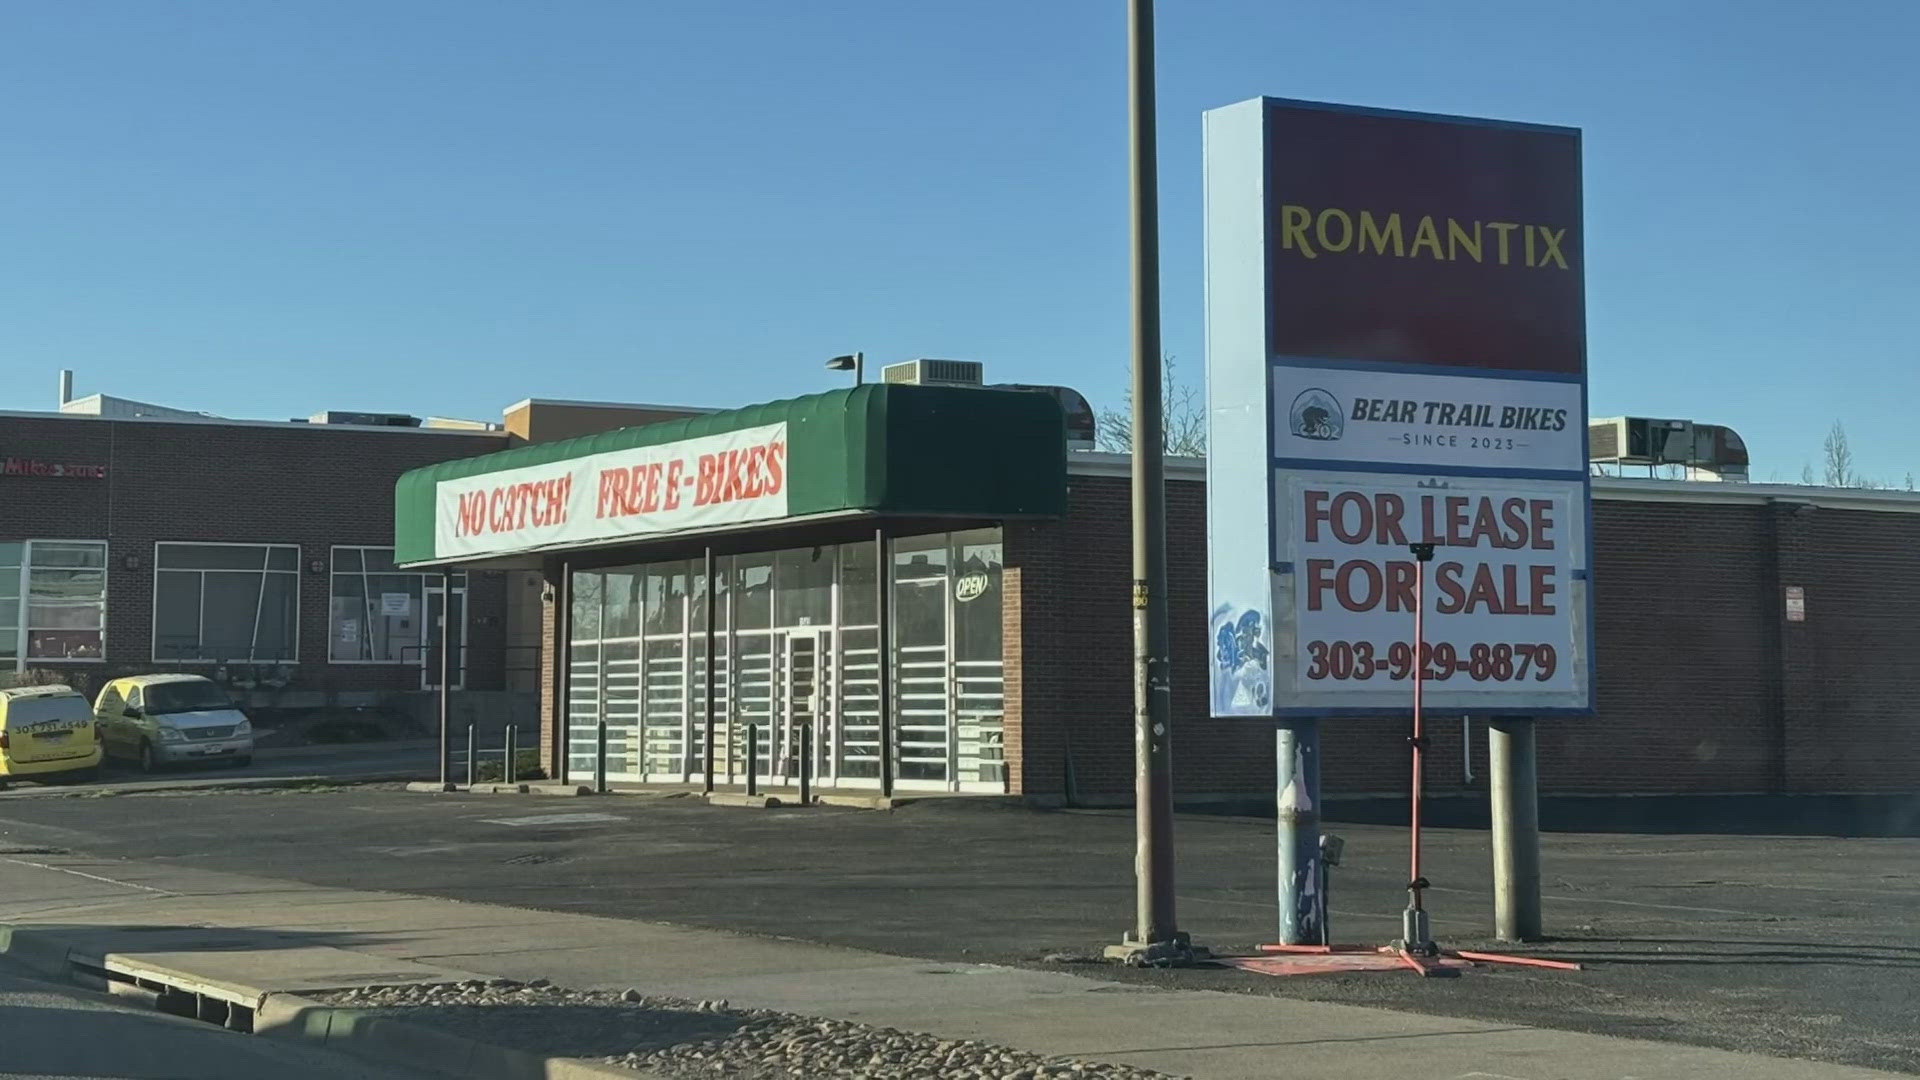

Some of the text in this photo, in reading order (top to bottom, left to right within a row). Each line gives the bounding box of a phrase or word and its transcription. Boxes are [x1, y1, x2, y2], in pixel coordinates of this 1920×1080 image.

[1281, 204, 1569, 270] ROMANTIX
[1351, 398, 1567, 431] BEAR TRAIL BIKES
[1403, 433, 1514, 450] SINCE 2023
[455, 490, 486, 538] NO
[489, 471, 572, 534] CATCH!
[596, 463, 663, 520] FREE
[1304, 491, 1555, 550] FOR LEASE
[957, 576, 984, 595] OPEN
[1306, 559, 1556, 616] FOR SALE
[1307, 640, 1557, 682] 303-929-8879
